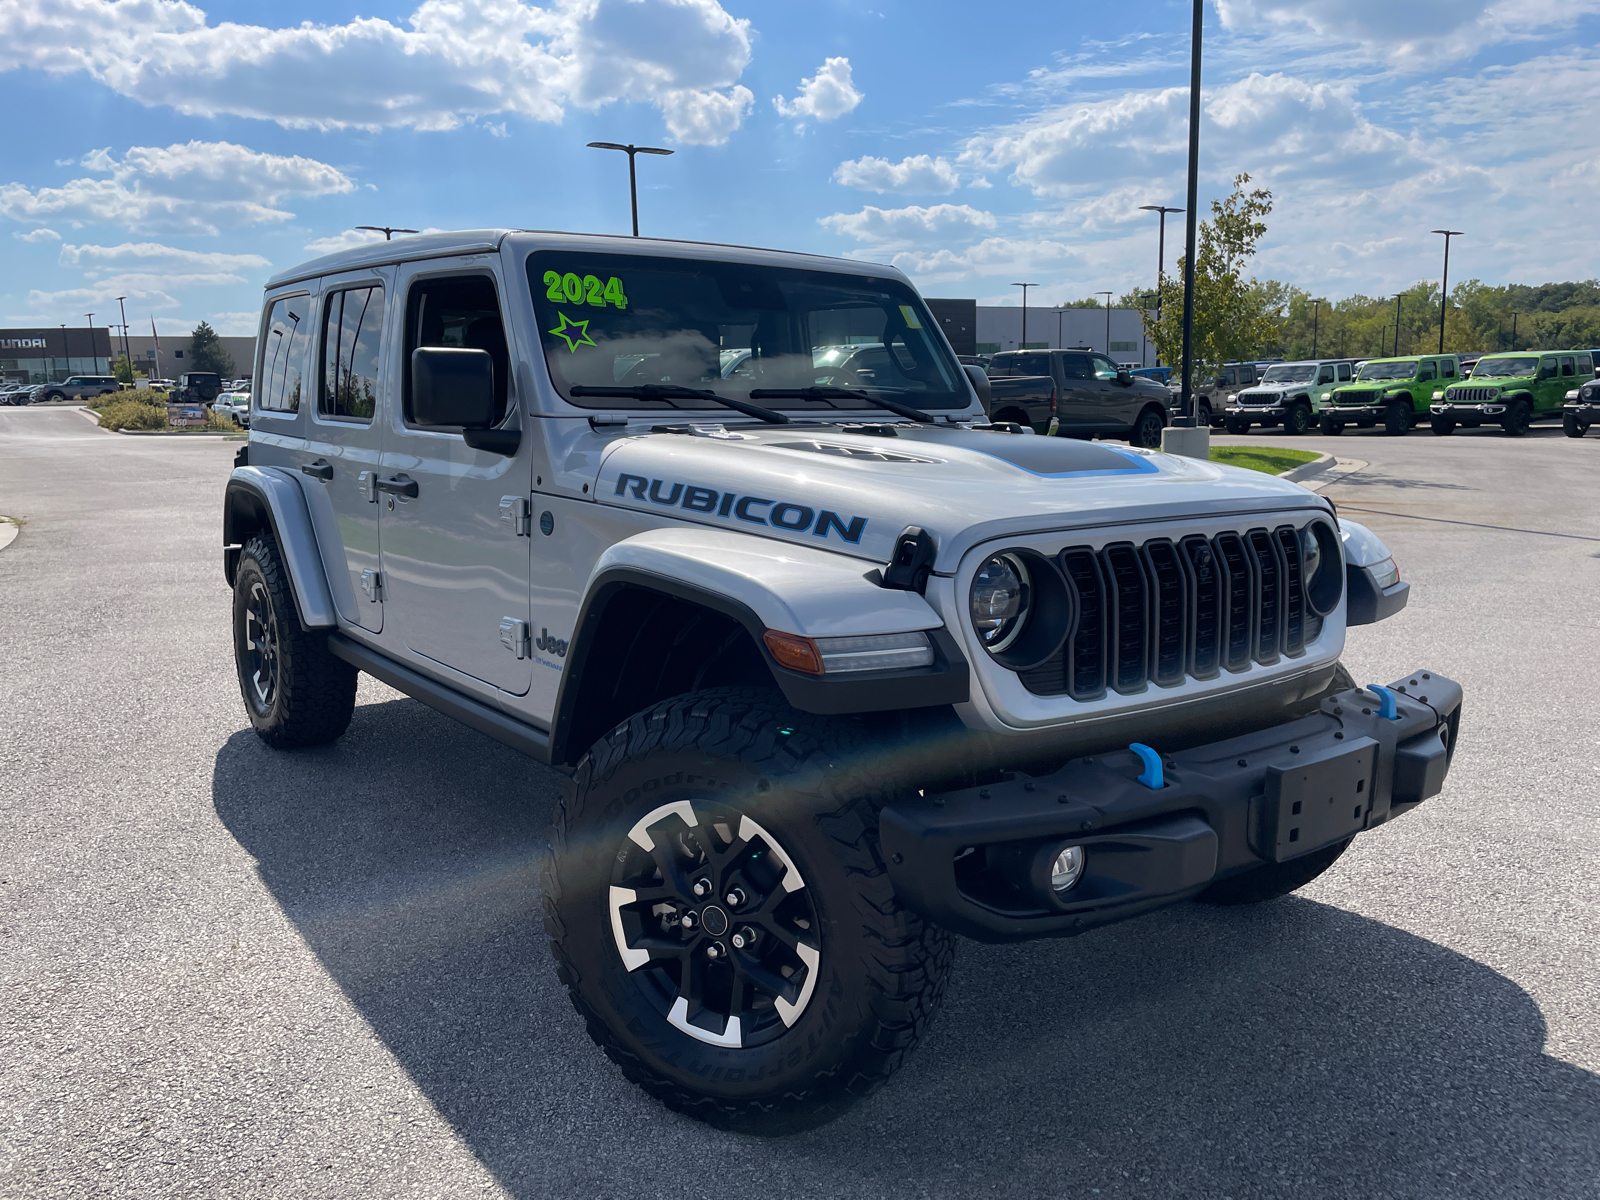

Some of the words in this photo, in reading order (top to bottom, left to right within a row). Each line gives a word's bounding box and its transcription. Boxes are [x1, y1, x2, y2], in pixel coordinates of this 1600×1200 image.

[543, 270, 628, 309] 2024
[0, 338, 47, 348] UNDAI
[613, 472, 869, 545] RUBICON
[536, 627, 569, 657] Jee
